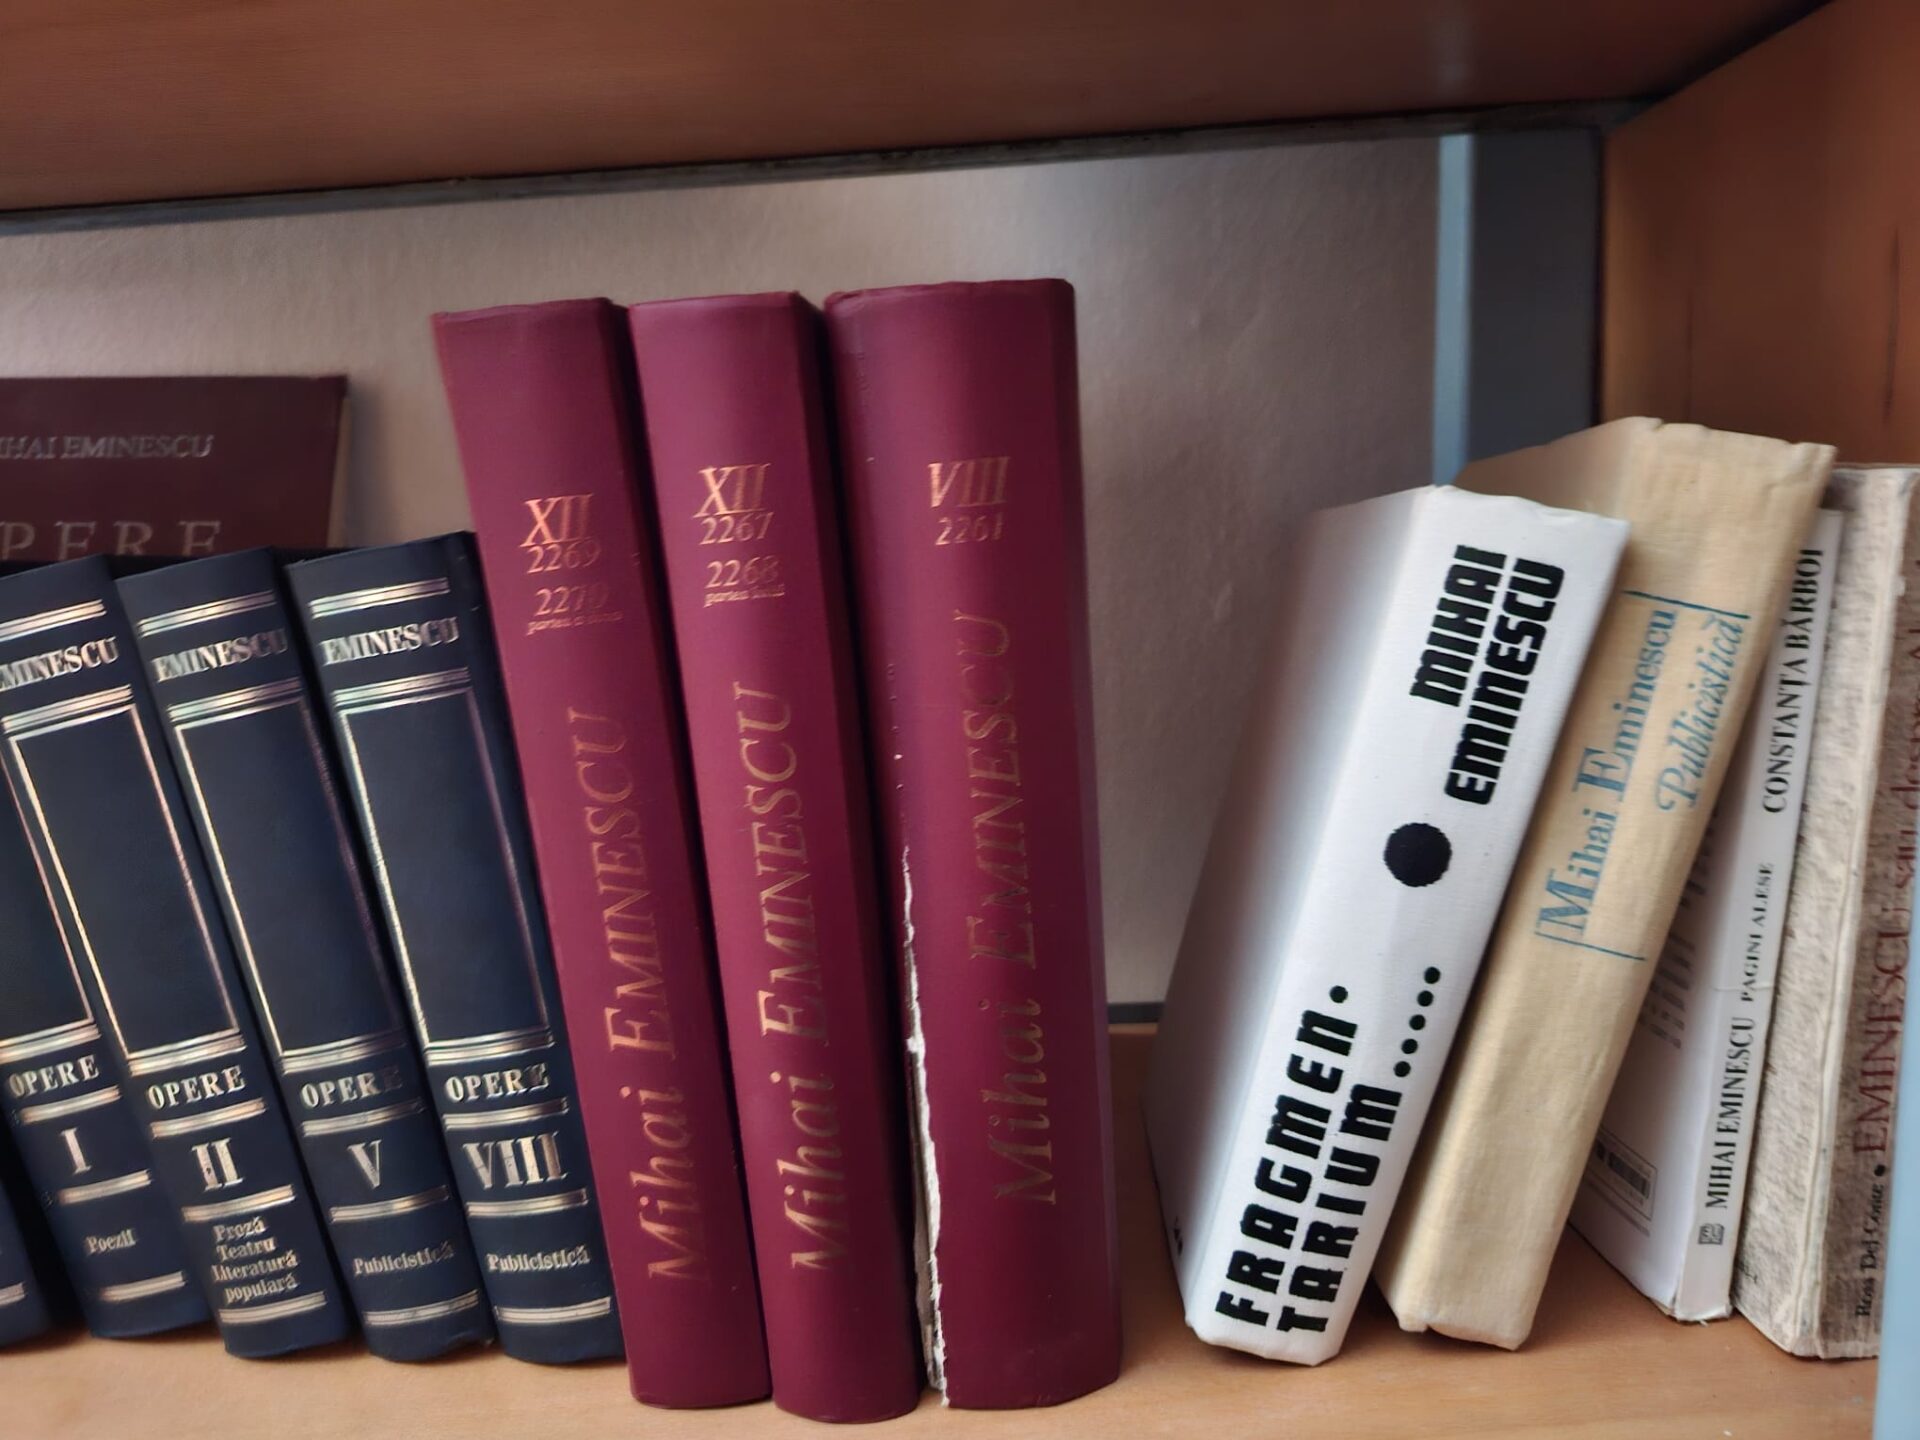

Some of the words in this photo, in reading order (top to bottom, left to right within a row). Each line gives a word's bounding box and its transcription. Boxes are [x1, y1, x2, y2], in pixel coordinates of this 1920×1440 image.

[60, 434, 214, 459] EMINESCU
[692, 463, 772, 519] XII
[928, 457, 1010, 508] VIII
[519, 493, 594, 547] XII
[700, 511, 774, 545] 2267
[935, 515, 1002, 546] 2261
[526, 540, 602, 574] 2269
[321, 617, 460, 665] EMINESCU
[1410, 544, 1508, 708] MIHAI
[0, 636, 119, 692] MINESCU
[152, 628, 290, 683] EMINESCU
[1444, 556, 1566, 805] EMINESCU
[1570, 608, 1680, 804] Eminescu
[1654, 617, 1748, 812] Publicistică
[953, 608, 1037, 970] EMINESCU
[566, 706, 677, 1062] EMINESCU
[733, 680, 830, 1048] EMINESCU
[1534, 808, 1620, 940] Mihai
[1741, 933, 1763, 1001] PAGINI
[1754, 862, 1773, 929] ALESE
[1852, 904, 1914, 1154] EMINESCU
[8, 1055, 101, 1098] OPERE
[147, 1066, 248, 1110] OPERE
[301, 1070, 402, 1109] OPERE
[445, 1064, 551, 1102] OPERE
[978, 997, 1057, 1206] Mihai
[1716, 1015, 1757, 1132] EMINESCU
[60, 1127, 94, 1175] I
[192, 1138, 244, 1191] II
[347, 1141, 383, 1189] V
[461, 1131, 568, 1189] VIII
[768, 1070, 848, 1272] Mihai
[1705, 1132, 1739, 1210] MIHAI
[618, 1085, 702, 1280] Mihai
[216, 1236, 276, 1262] Teatru
[1860, 1233, 1882, 1274] Del
